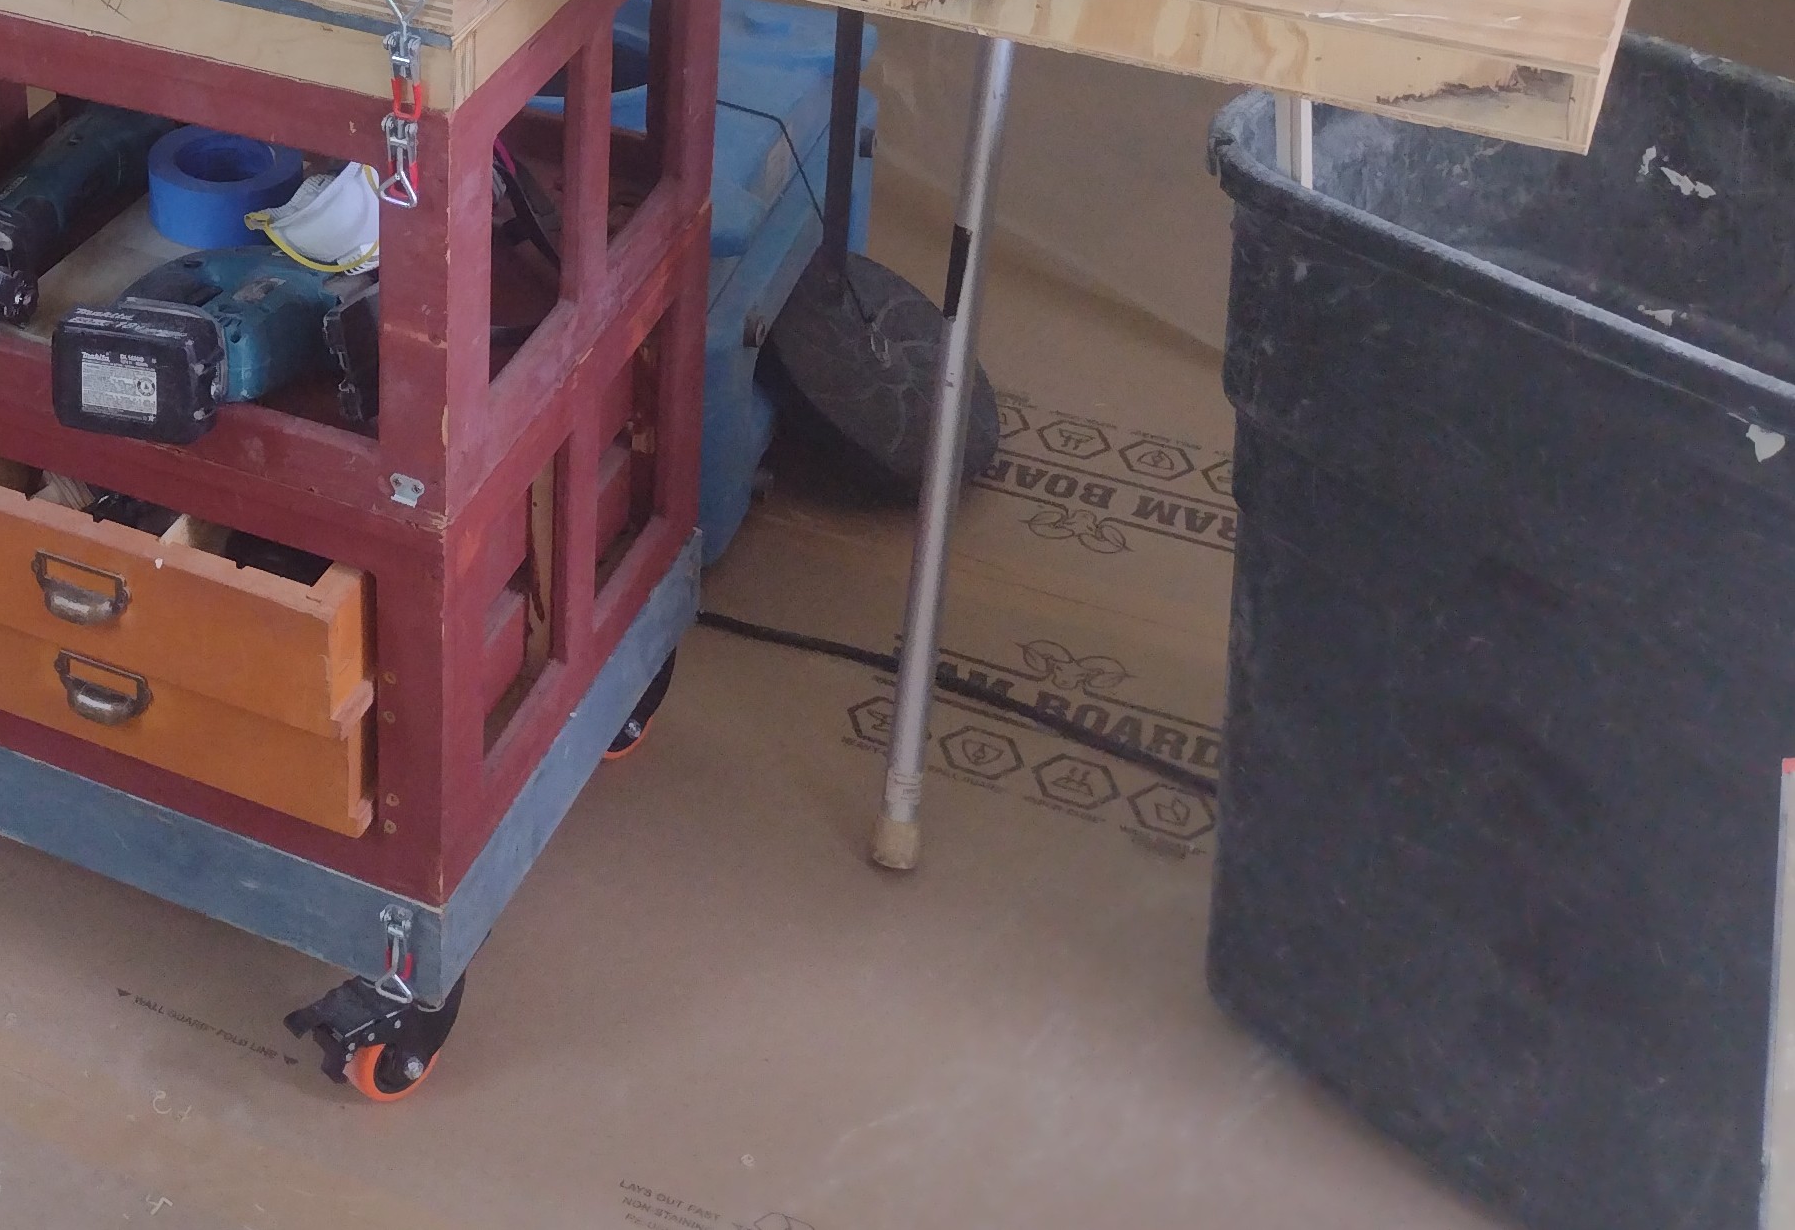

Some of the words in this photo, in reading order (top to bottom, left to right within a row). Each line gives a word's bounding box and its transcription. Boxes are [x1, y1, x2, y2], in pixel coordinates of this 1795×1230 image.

[979, 459, 1117, 509] BOAR
[1131, 494, 1237, 543] RAM
[619, 1178, 653, 1198] LAYS
[656, 1192, 685, 1209] OUT
[687, 1204, 722, 1222] FAST
